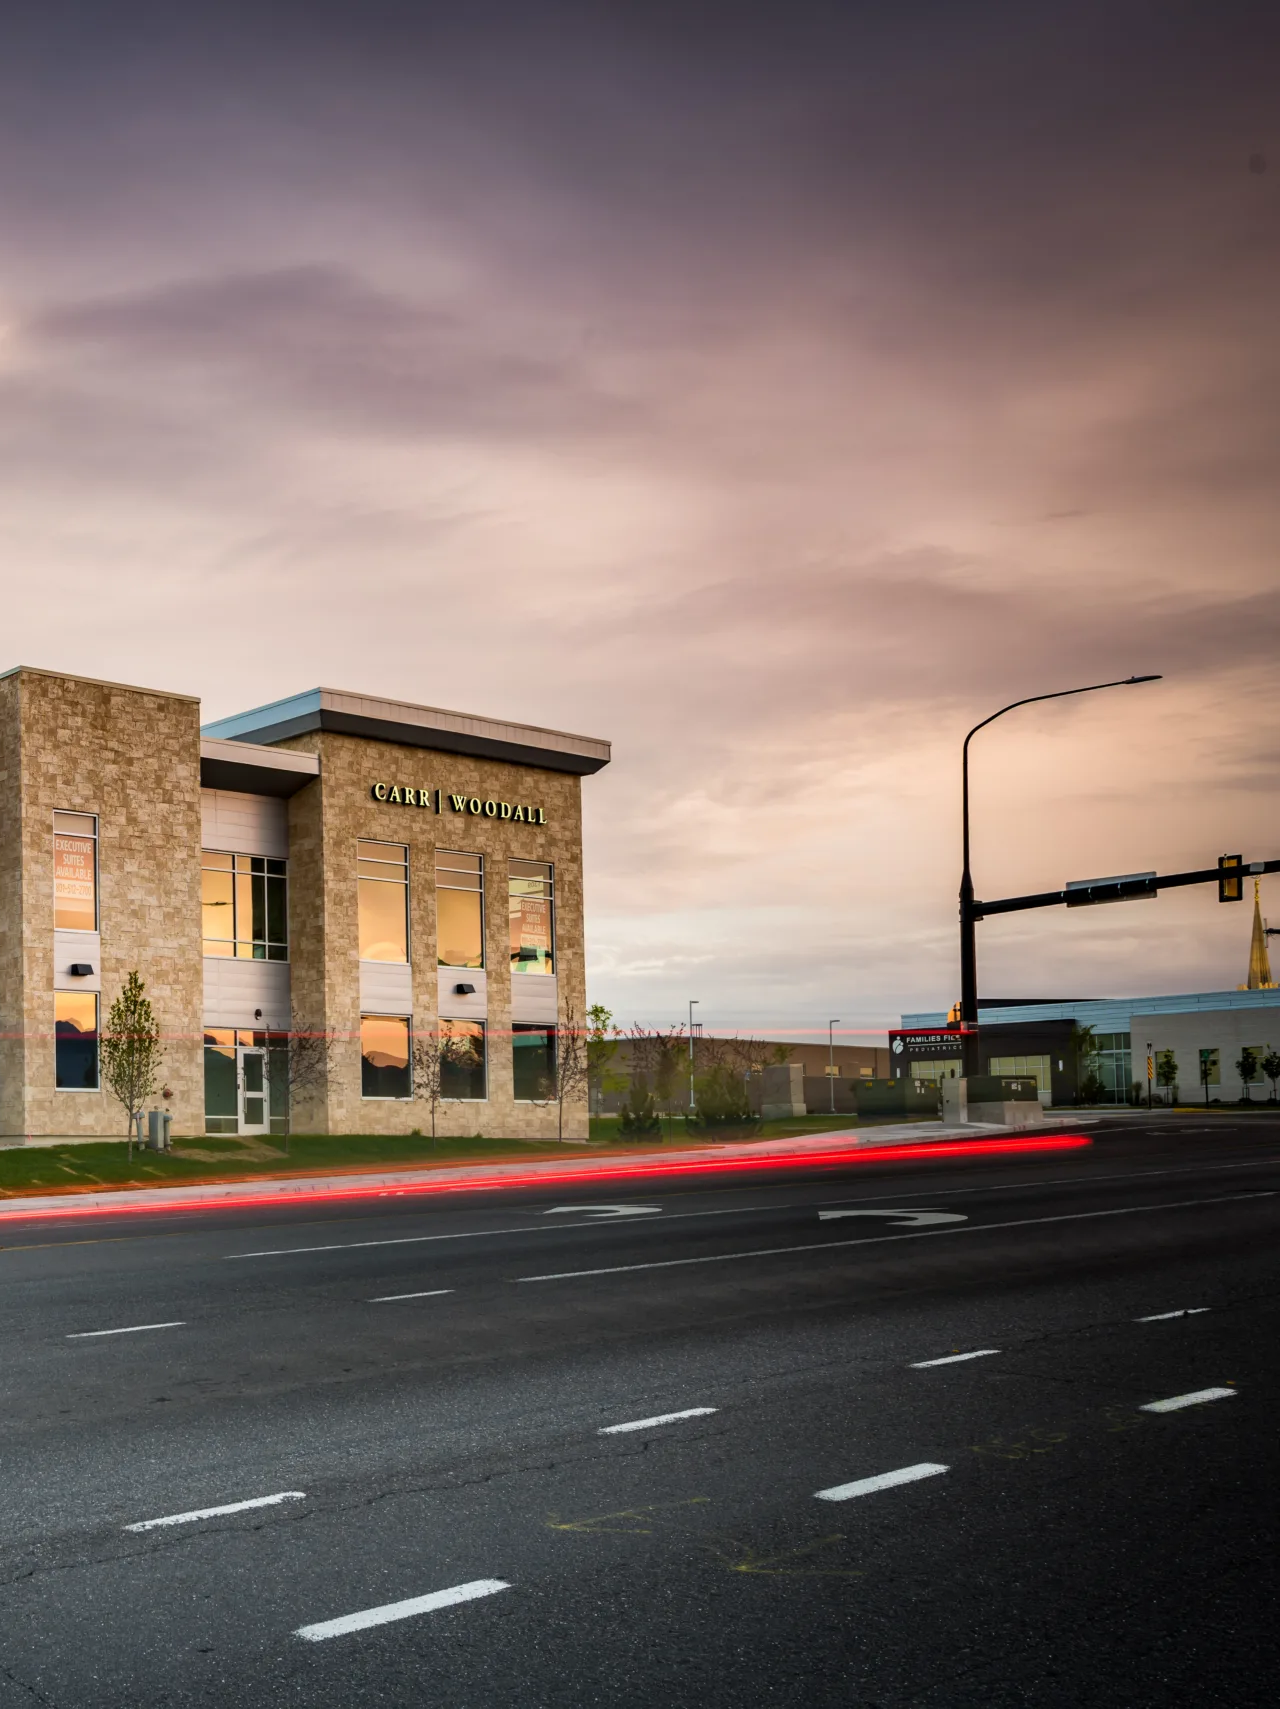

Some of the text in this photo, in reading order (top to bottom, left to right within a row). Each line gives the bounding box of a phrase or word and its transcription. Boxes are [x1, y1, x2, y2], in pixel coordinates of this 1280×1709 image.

[373, 782, 548, 824] CARR WOODALL
[55, 839, 92, 854] EXECUTIVE
[63, 853, 85, 867] SUITES
[55, 866, 92, 880] AVAILABLE
[906, 1035, 941, 1043] FAMILIES
